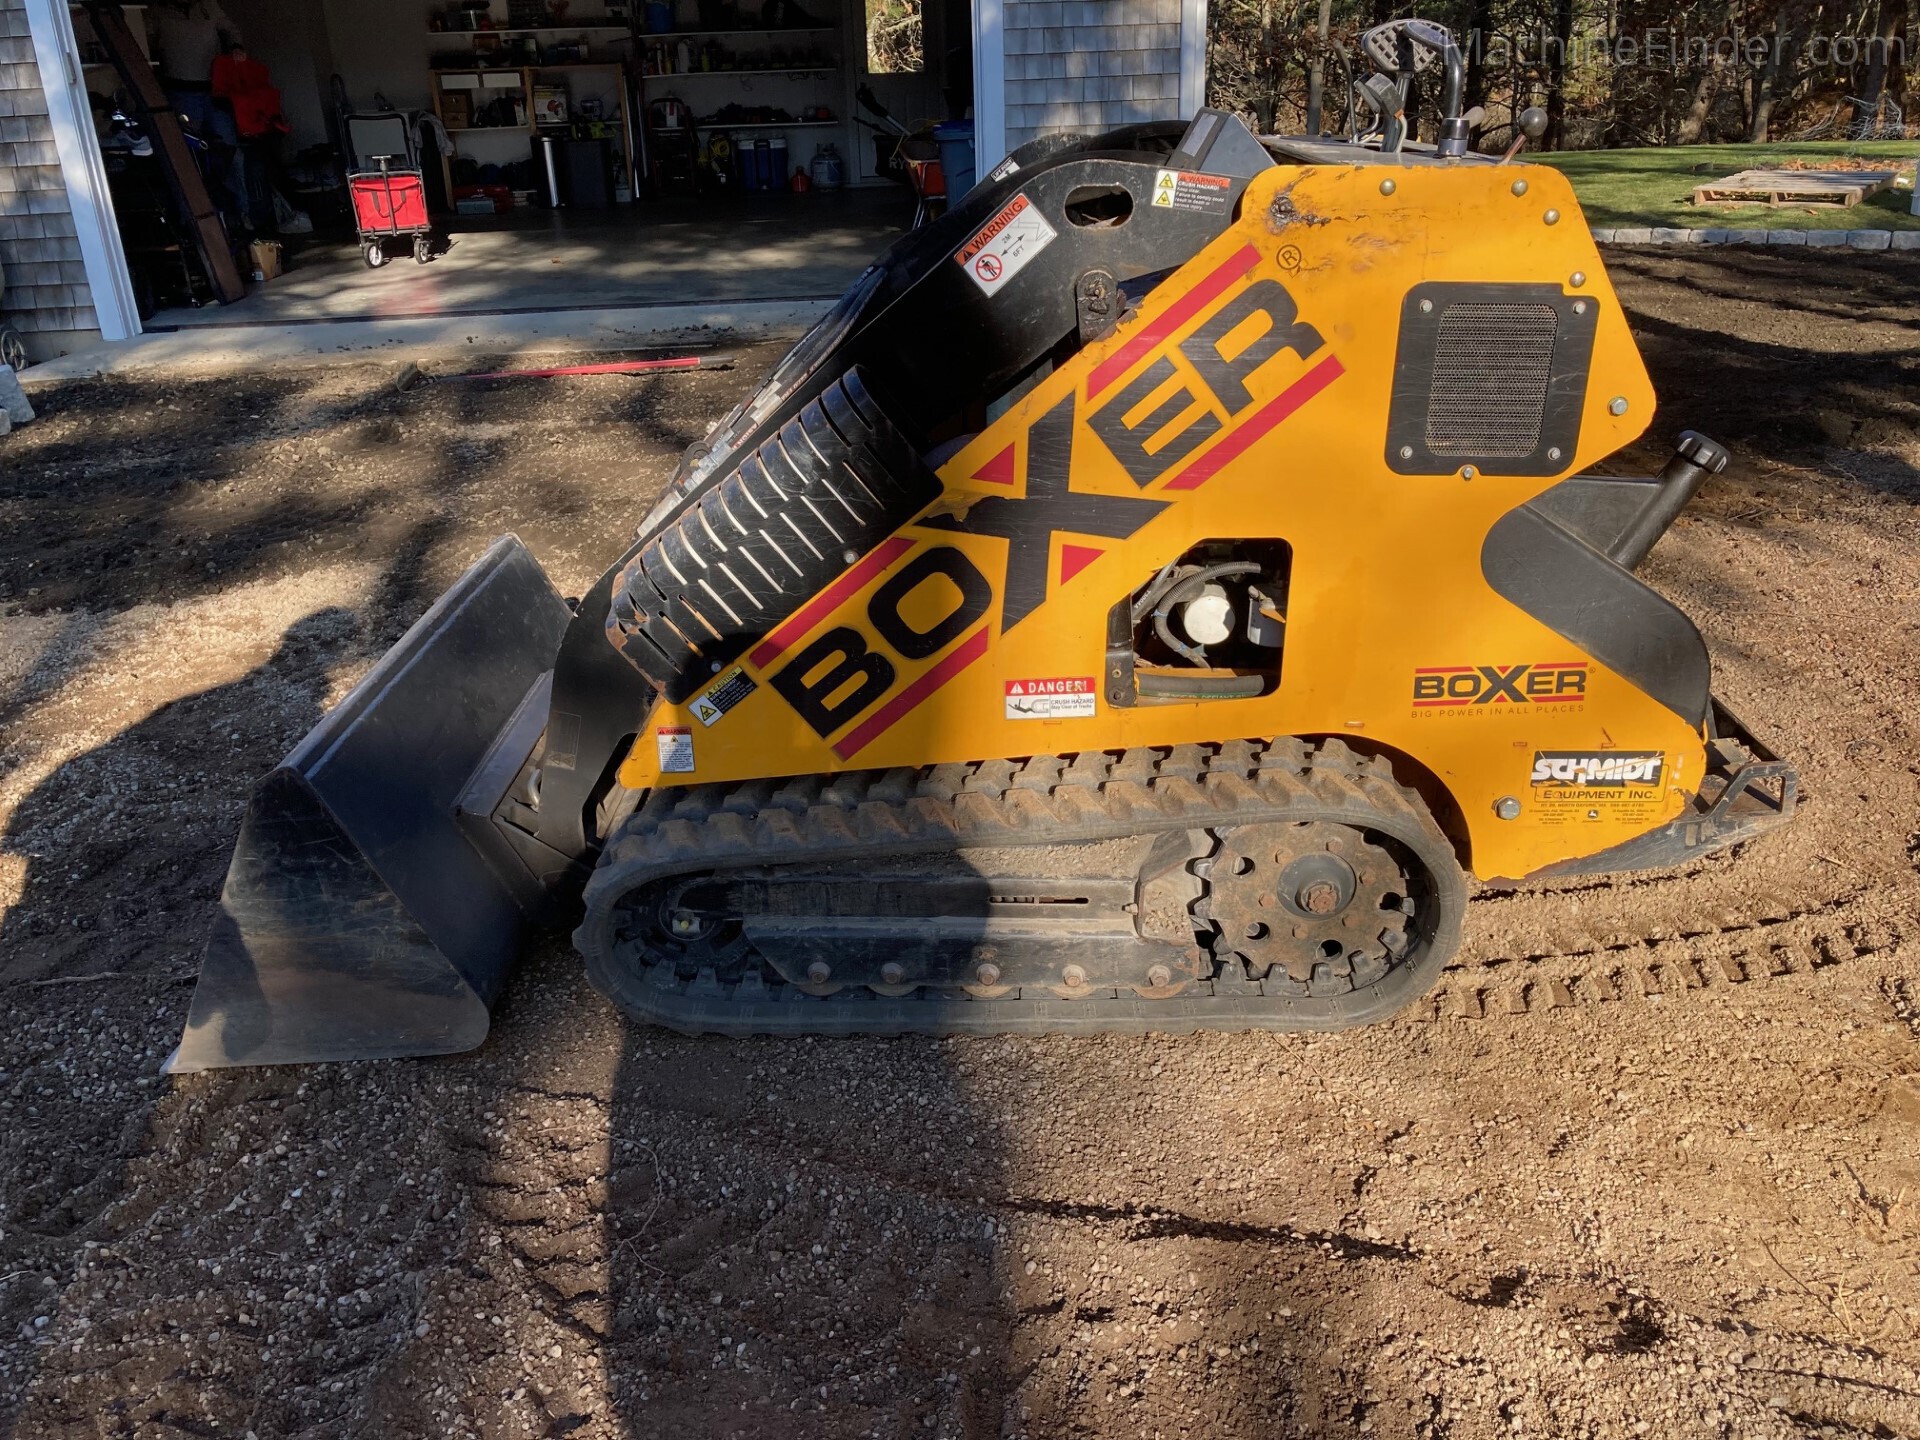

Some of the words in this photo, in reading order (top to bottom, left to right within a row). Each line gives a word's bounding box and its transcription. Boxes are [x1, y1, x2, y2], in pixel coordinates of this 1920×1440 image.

[1189, 174, 1223, 185] WARNING
[971, 201, 1023, 250] WARNING
[1001, 233, 1012, 244] 2M
[1012, 245, 1025, 257] 6FT
[769, 279, 1327, 739] BOXER
[713, 671, 737, 691] CAUTION
[1028, 680, 1087, 694] DANGER!
[1413, 664, 1587, 704] BOXER
[719, 691, 728, 699] NOT
[1439, 708, 1483, 717] POWER
[1490, 707, 1502, 716] IN
[1536, 704, 1585, 713] PLACES
[1530, 758, 1662, 784] SCHMIDT
[1543, 790, 1625, 799] EQUIPMENT
[1628, 790, 1657, 799] INC.
